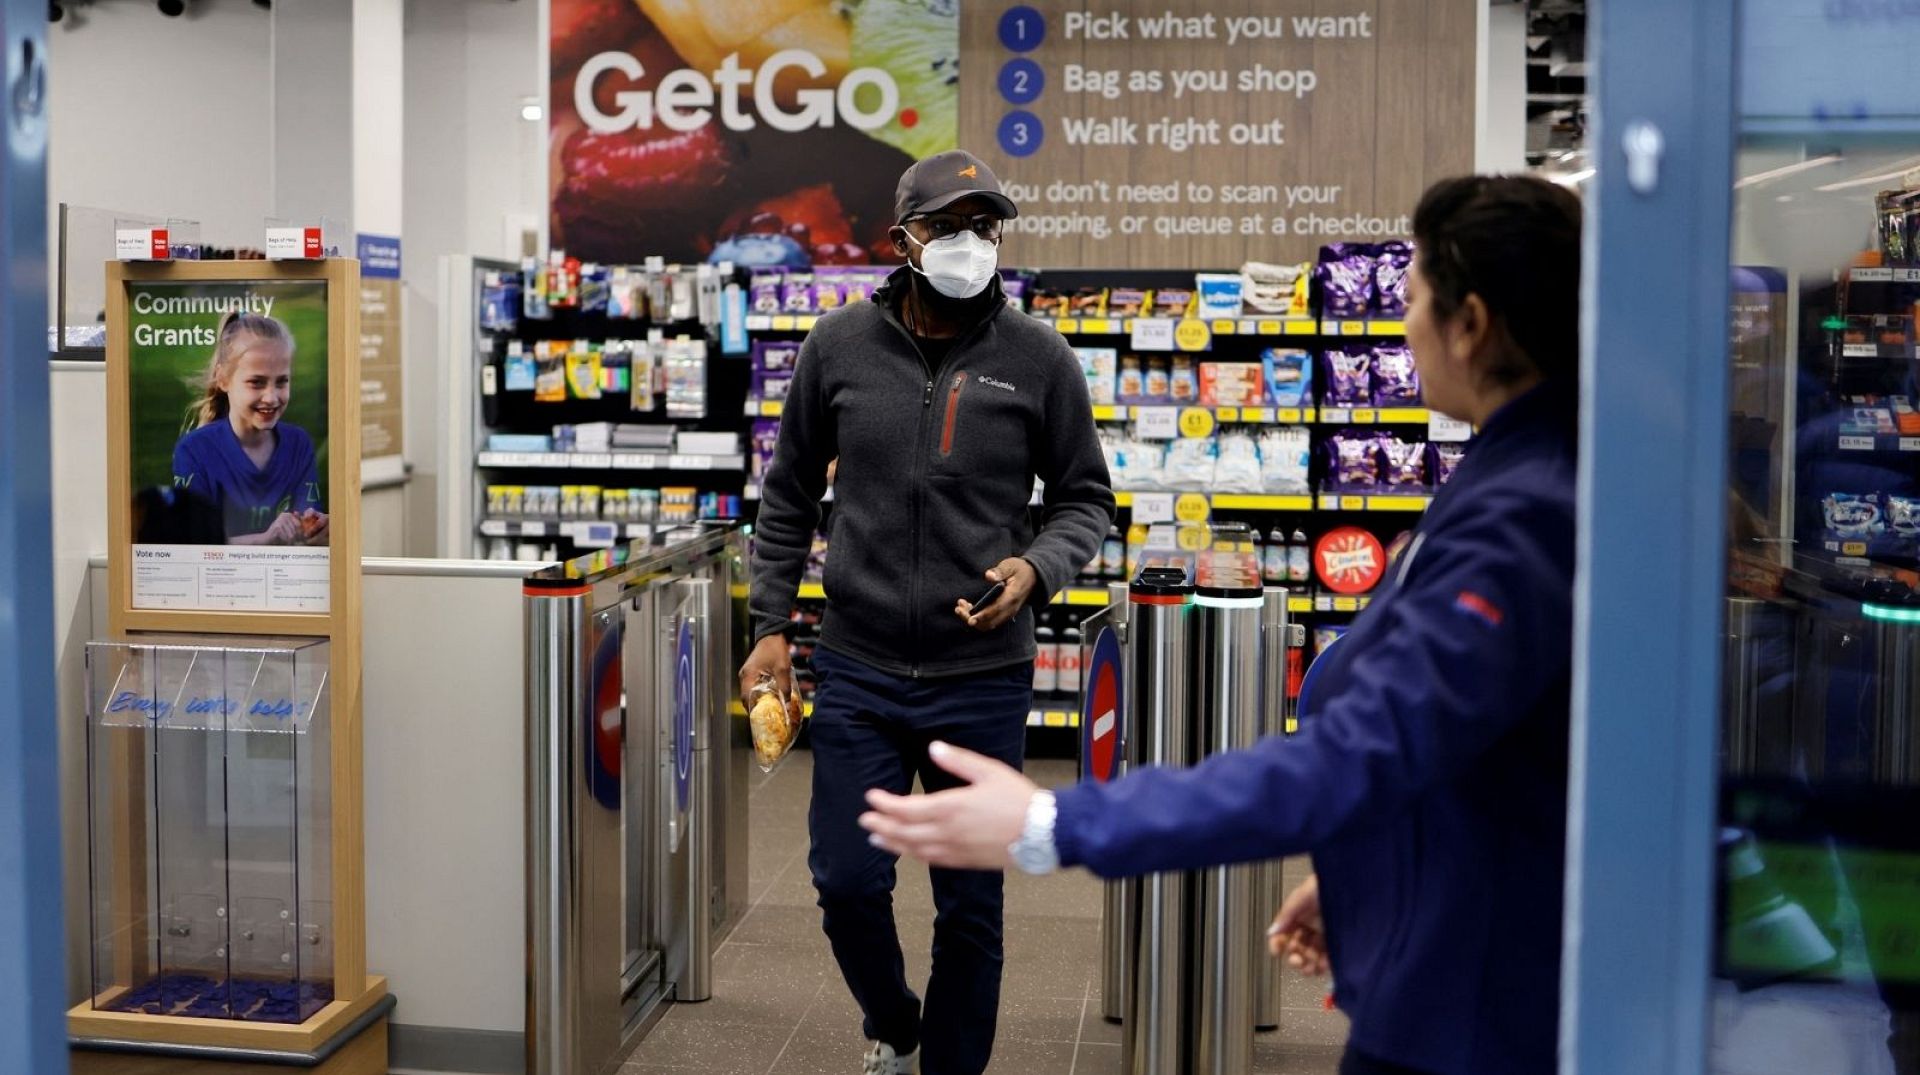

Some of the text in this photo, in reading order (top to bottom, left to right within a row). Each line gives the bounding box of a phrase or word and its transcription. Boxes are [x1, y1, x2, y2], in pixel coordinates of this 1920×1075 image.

[1015, 18, 1026, 39] 1
[1063, 12, 1372, 45] Pick what you want
[1013, 70, 1028, 94] 2
[1063, 64, 1317, 99] Bag as you shop
[1013, 123, 1028, 145] 3
[1062, 117, 1284, 152] Walk right out
[997, 180, 1342, 208] You don't need to scan your
[1119, 216, 1147, 235] or
[1154, 216, 1233, 241] queue
[1239, 214, 1264, 235] at
[1272, 218, 1287, 235] a
[134, 290, 274, 319] Community
[134, 323, 216, 347] Grants
[135, 550, 153, 558] Vote
[228, 552, 251, 561] Helping
